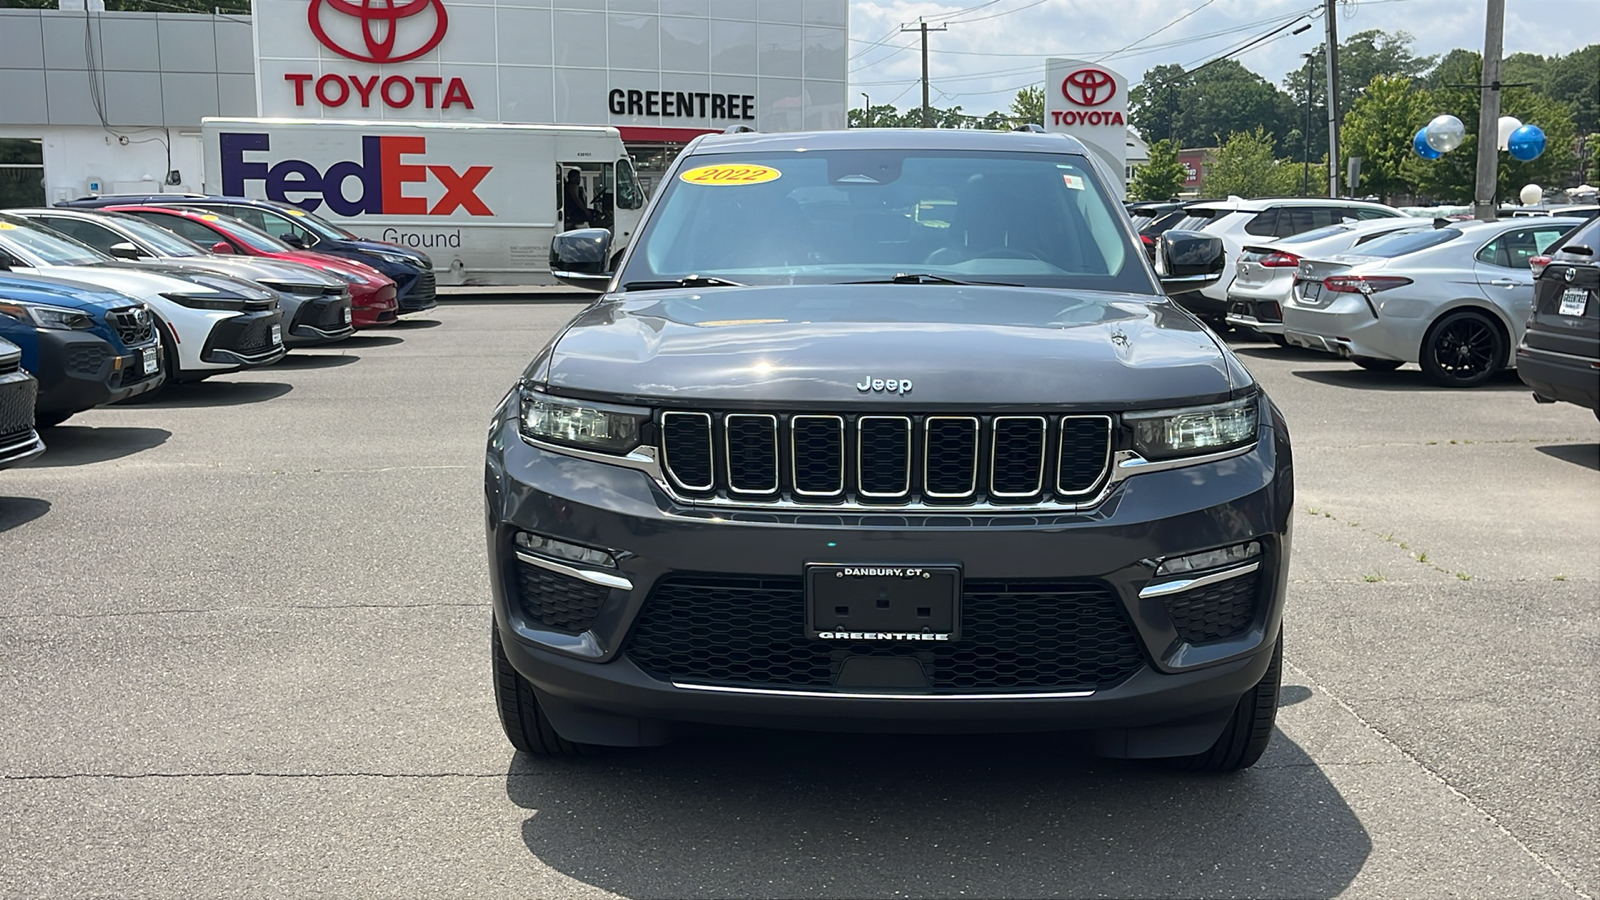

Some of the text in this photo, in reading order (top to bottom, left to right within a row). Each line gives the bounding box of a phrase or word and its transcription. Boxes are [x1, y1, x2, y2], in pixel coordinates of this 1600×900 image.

[284, 73, 475, 110] TOYOTA
[608, 88, 755, 120] GREENTREE
[1051, 110, 1124, 126] TOYOTA
[219, 132, 494, 217] FedEx
[693, 168, 768, 181] 2022
[382, 227, 461, 248] Ground
[856, 375, 913, 394] Jeep
[844, 568, 923, 577] DANBURY, CT
[818, 631, 949, 641] GREENTREE
